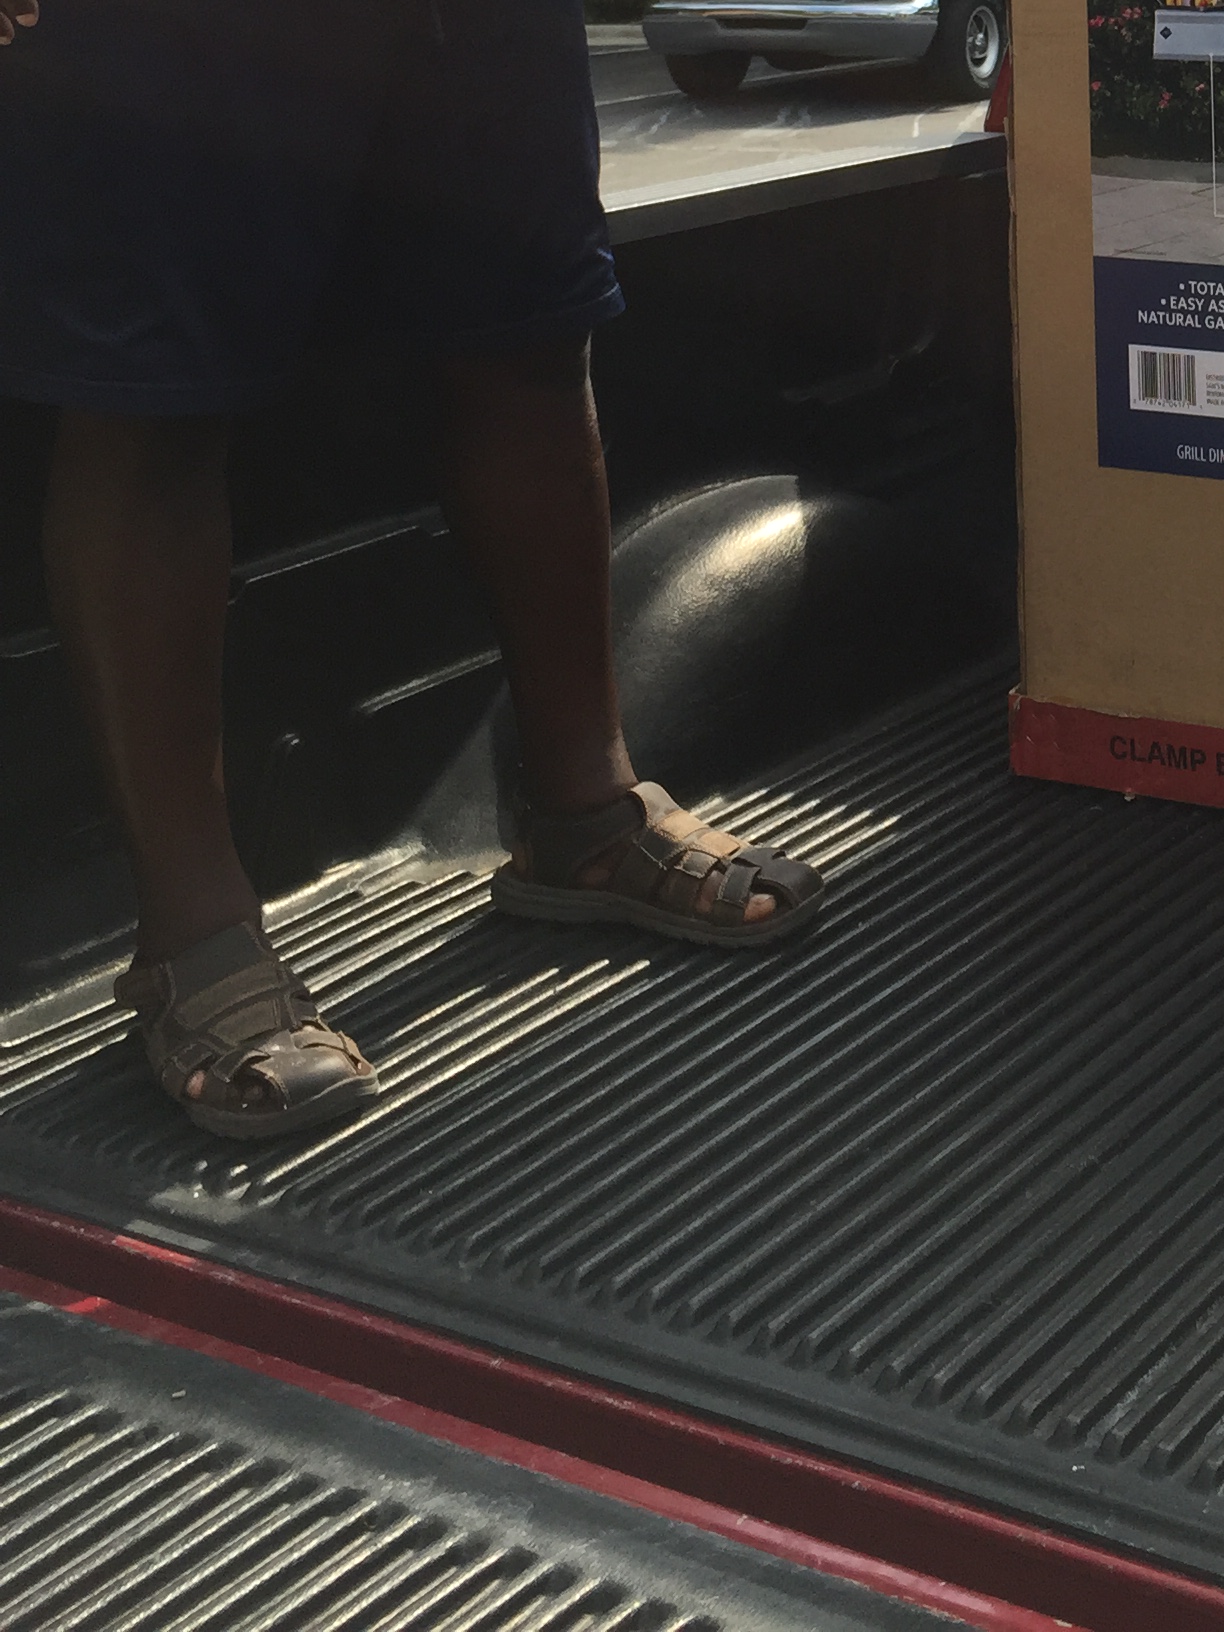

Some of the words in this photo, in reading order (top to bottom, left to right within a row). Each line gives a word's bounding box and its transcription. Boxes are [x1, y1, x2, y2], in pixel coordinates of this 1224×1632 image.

[1170, 296, 1204, 312] EASY
[1137, 310, 1202, 328] NATURAL
[1176, 444, 1206, 462] GRILL
[1109, 735, 1207, 772] CLAMP
